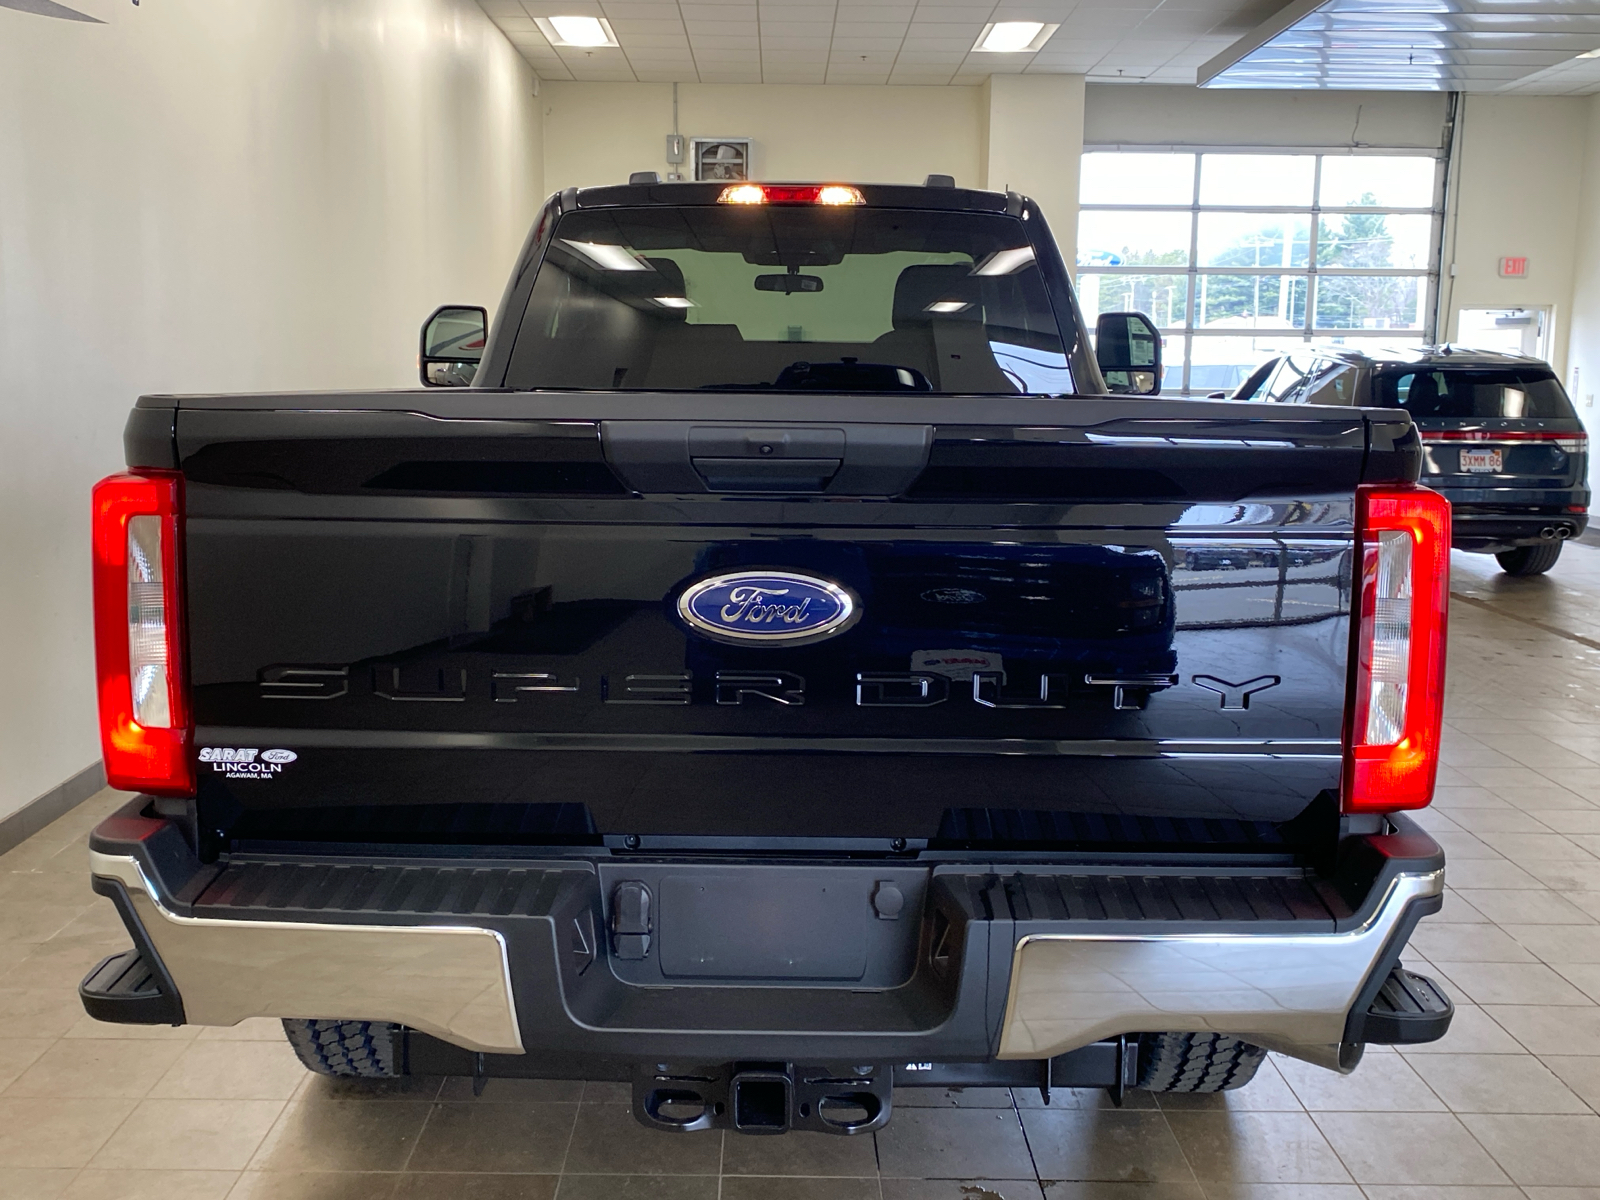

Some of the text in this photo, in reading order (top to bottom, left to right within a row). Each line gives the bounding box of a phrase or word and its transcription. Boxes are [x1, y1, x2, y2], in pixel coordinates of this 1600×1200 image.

[1504, 257, 1526, 274] EXIT
[1488, 455, 1501, 467] 86
[720, 586, 812, 624] Ford
[258, 663, 1280, 711] SUPER DUTY
[198, 747, 259, 763] SARAT
[213, 762, 282, 773] LINCOLN
[225, 771, 260, 779] AGAWAM,
